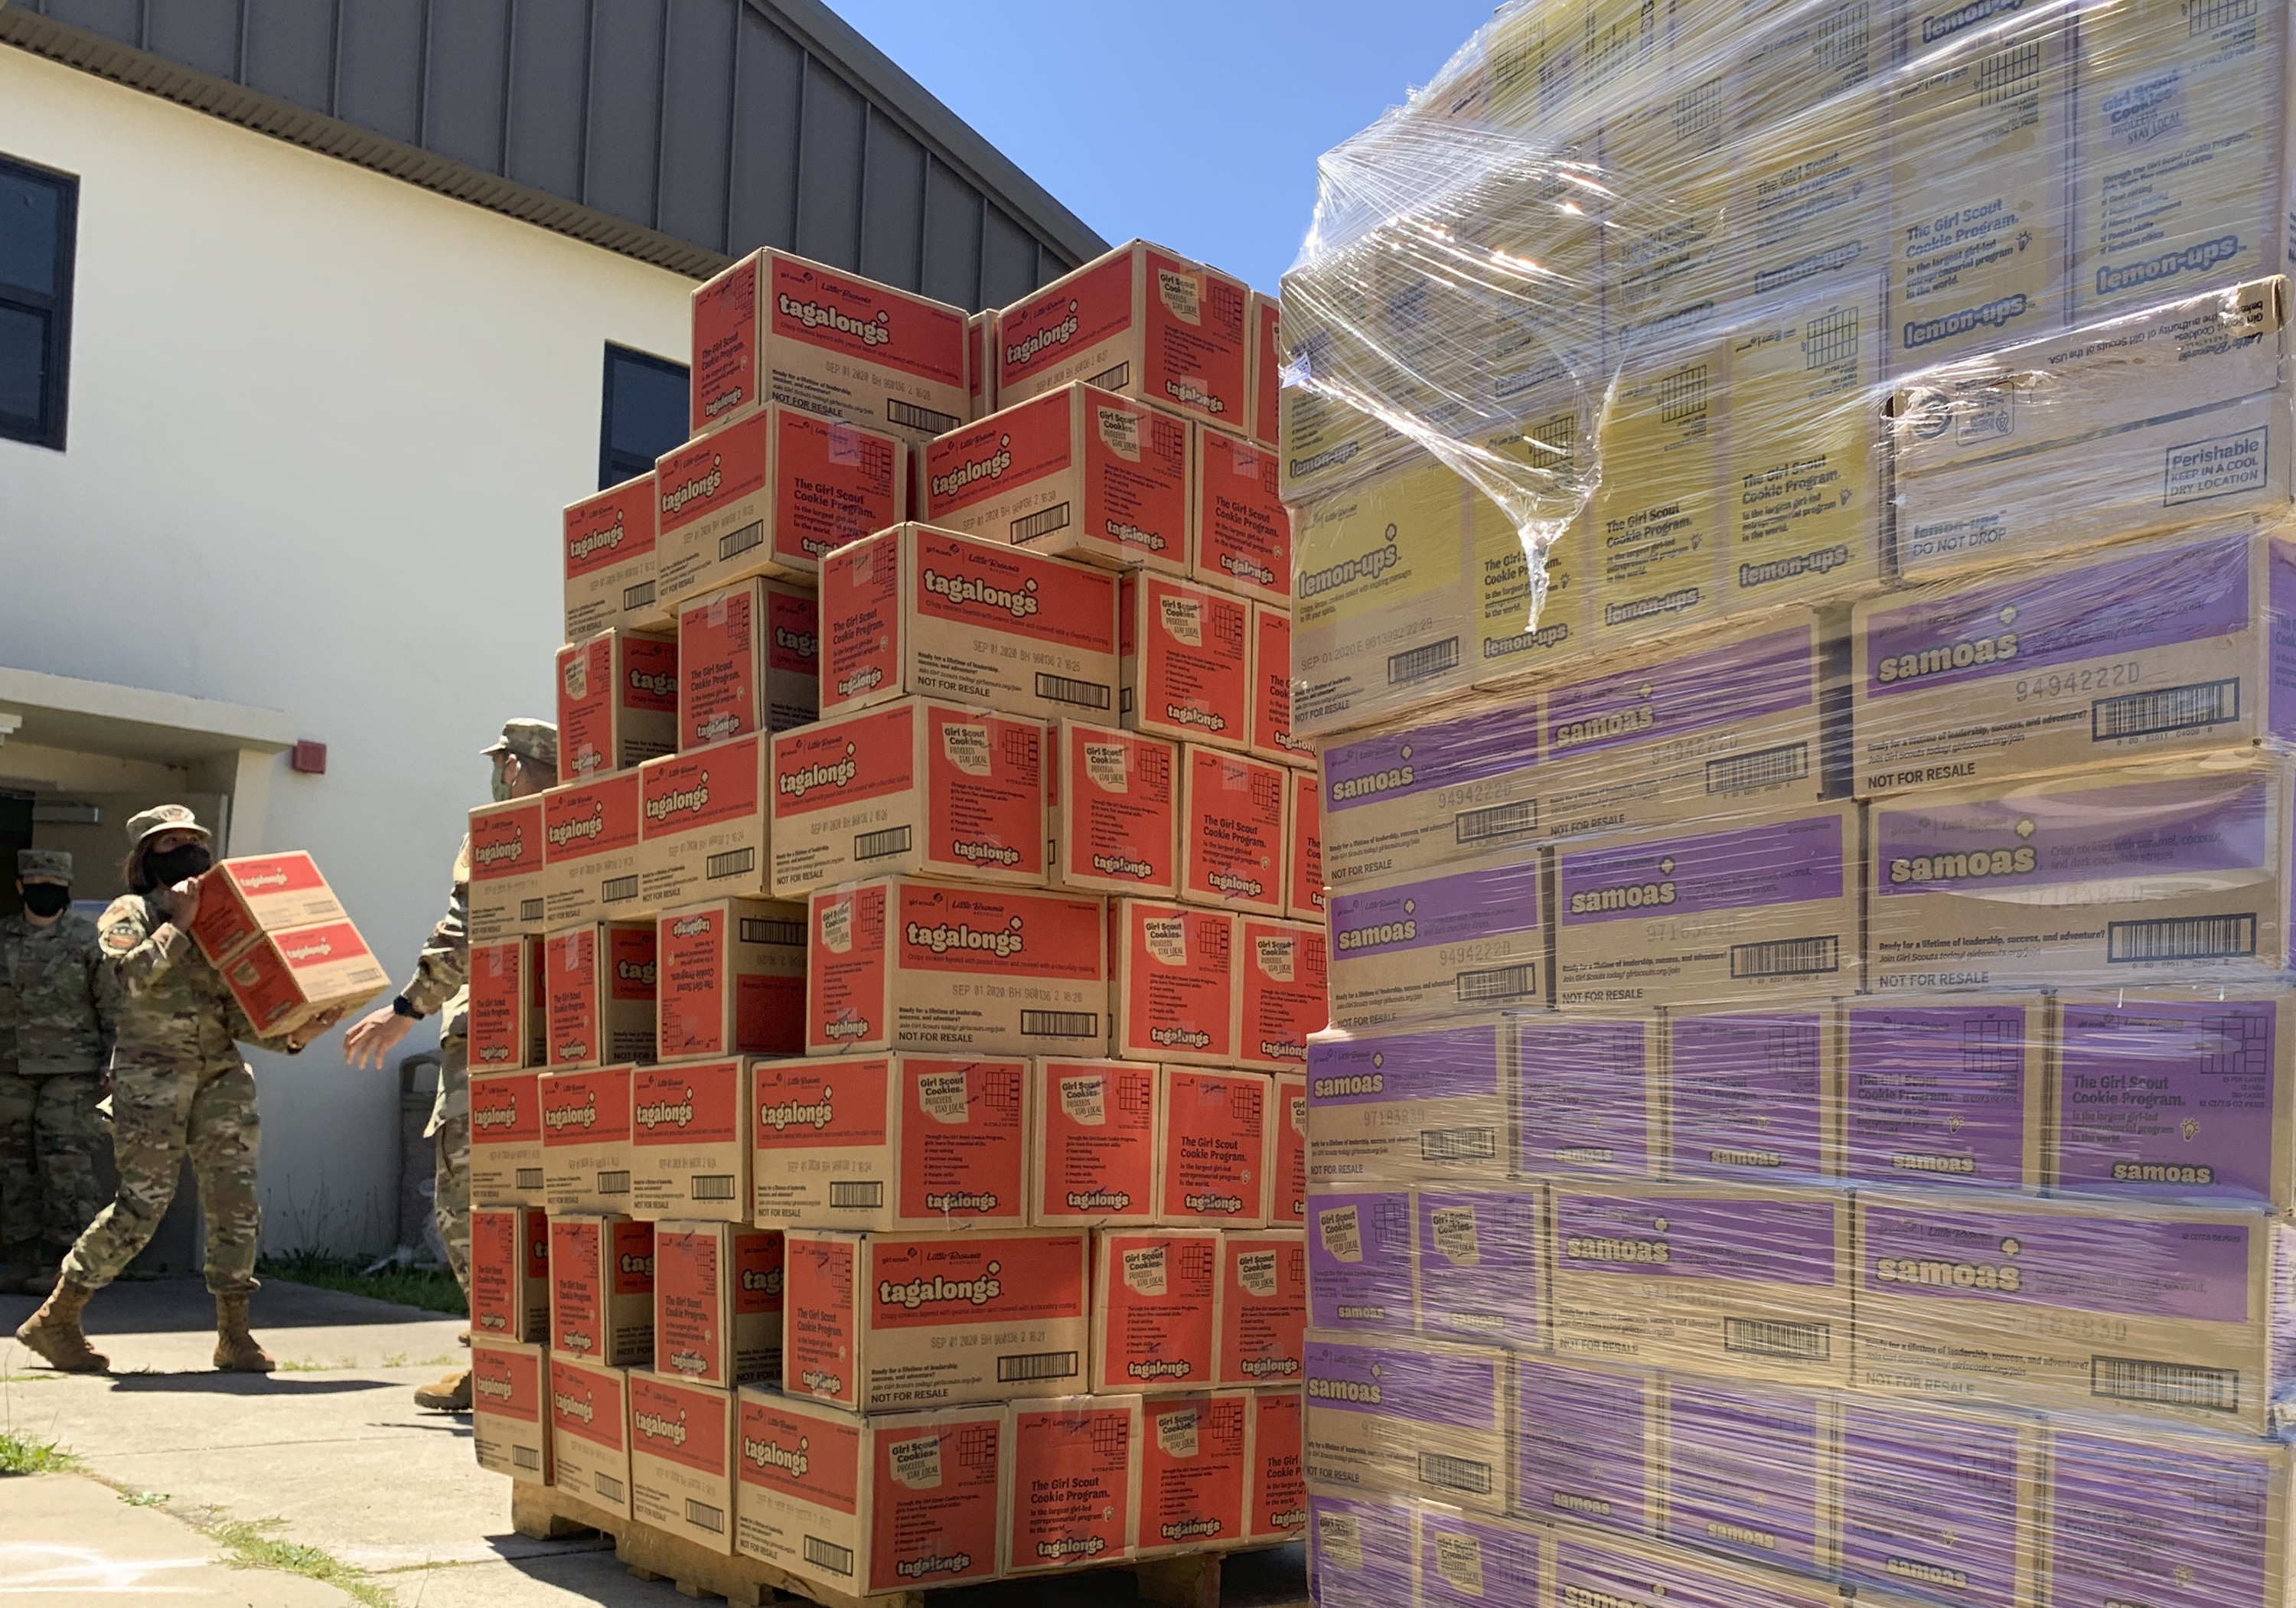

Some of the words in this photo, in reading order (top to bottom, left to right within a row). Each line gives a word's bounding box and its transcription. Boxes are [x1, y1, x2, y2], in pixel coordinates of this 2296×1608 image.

[2097, 235, 2238, 295] lemon-ups
[778, 292, 890, 346] tagalongs
[1904, 294, 2027, 349] lemon-ups
[2158, 317, 2201, 337] authority
[1005, 314, 1078, 367] tagalongs
[2096, 338, 2127, 352] Scouts
[2128, 334, 2145, 347] Girl
[2069, 349, 2083, 359] the
[705, 386, 742, 417] tagalongs
[1165, 379, 1225, 413] tagalongs
[1290, 441, 1359, 478] lemon-ups
[2173, 438, 2259, 469] Perishable
[931, 449, 1010, 496] tagalongs
[2172, 469, 2198, 482] KEEP
[2202, 465, 2213, 476] IN
[2216, 464, 2224, 473] A
[2227, 457, 2258, 471] COOL
[661, 469, 721, 514] tagalongs
[2170, 484, 2193, 496] DRY
[2198, 470, 2258, 491] LOCATION
[569, 523, 624, 559] tagalongs
[1106, 519, 1165, 550] tagalongs
[1913, 543, 1935, 557] DO
[1937, 535, 1965, 553] NOT
[1969, 527, 2007, 546] DROP
[1220, 553, 1274, 585] tagalongs
[1299, 544, 1397, 599] lemon-ups
[1739, 544, 1848, 588] lemon-ups
[924, 569, 1038, 618] tagalongs
[1604, 587, 1699, 626] lemon-ups
[1301, 656, 1319, 671] SEP
[1322, 653, 1333, 664] 01
[1335, 645, 1355, 660] 2020
[1356, 641, 1363, 652] E
[1365, 628, 1403, 649] 9613992
[1484, 623, 1568, 658] lemon-ups
[1877, 634, 2018, 684] samoas
[837, 667, 882, 696] tagalongs
[2016, 661, 2140, 702] 9494222D
[1166, 703, 1225, 731] tagalongs
[1295, 713, 1309, 723] NOT
[1310, 707, 1323, 719] FOR
[1325, 700, 1350, 714] RESALE
[696, 716, 739, 739] tagalongs
[1555, 706, 1655, 749] samoas
[779, 757, 856, 796] tagalongs
[1332, 765, 1414, 802] samoas
[1868, 775, 1894, 789] NOT
[1898, 770, 1923, 784] FOR
[1927, 763, 1975, 781] RESALE
[646, 786, 709, 820] tagalongs
[548, 817, 603, 846] tagalongs
[475, 840, 523, 865] tagalongs
[953, 840, 1019, 866] tagalongs
[1890, 846, 2037, 885] samoas
[1093, 853, 1152, 879] tagalongs
[1208, 872, 1262, 897] tagalongs
[1570, 880, 1677, 915] samoas
[906, 921, 1022, 957] tagalongs
[1338, 920, 1417, 951] samoas
[1879, 942, 1900, 951] Ready
[1923, 939, 1951, 948] lifetime
[1952, 938, 1961, 947] of
[2043, 933, 2058, 941] and
[2060, 930, 2105, 941] adventure?
[1879, 954, 1895, 963] Join
[1896, 954, 1911, 962] Girl
[1913, 952, 1939, 961] Scouts
[1940, 951, 1965, 960] today!
[1880, 975, 1905, 987] NOT
[1910, 974, 1935, 986] FOR
[1940, 971, 1989, 984] RESALE
[952, 985, 970, 995] SEP
[987, 986, 1005, 997] 2020
[1009, 987, 1021, 998] BH
[1055, 991, 1059, 1000] 2
[899, 1032, 918, 1041] NOT
[920, 1033, 938, 1042] FOR
[941, 1034, 974, 1042] RESALE
[1150, 1027, 1211, 1047] tagalongs
[1313, 1073, 1384, 1099] samoas
[2073, 1075, 2096, 1088] The
[2101, 1075, 2125, 1088] Girl
[2129, 1076, 2168, 1089] Scout
[2073, 1091, 2118, 1104] Cookie
[545, 1104, 596, 1130] tagalongs
[637, 1101, 693, 1129] tagalongs
[760, 1100, 833, 1131] tagalongs
[1180, 1149, 1208, 1159] Cookie
[1181, 1137, 1195, 1147] The
[1198, 1138, 1213, 1148] Girl
[1215, 1140, 1238, 1149] Scout
[1710, 1150, 1781, 1166] samoas
[1892, 1153, 1976, 1173] samoas
[2112, 1163, 2213, 1185] samoas
[927, 1192, 997, 1212] tagalongs
[1067, 1190, 1130, 1208] tagalongs
[1186, 1193, 1242, 1212] tagalongs
[1566, 1235, 1671, 1265] samoas
[1876, 1256, 2023, 1293] samoas
[879, 1274, 1001, 1309] tagalongs
[1338, 1306, 1385, 1320] samoas
[1128, 1360, 1190, 1378] tagalongs
[1241, 1358, 1298, 1377] tagalongs
[1308, 1377, 1382, 1404] samoas
[634, 1411, 686, 1446] tagalongs
[743, 1435, 808, 1478] tagalongs
[892, 1445, 909, 1455] Girl
[912, 1440, 938, 1451] Scout
[897, 1460, 925, 1473] PROCEEDS
[907, 1470, 920, 1480] STAY
[921, 1466, 938, 1476] LOCAL
[1032, 1480, 1049, 1491] The
[1052, 1478, 1069, 1489] Girl
[1072, 1477, 1099, 1488] Scout
[1031, 1492, 1064, 1503] Cookie
[1161, 1518, 1221, 1538] tagalongs
[1036, 1537, 1104, 1558] tagalongs
[897, 1554, 971, 1577] tagalongs
